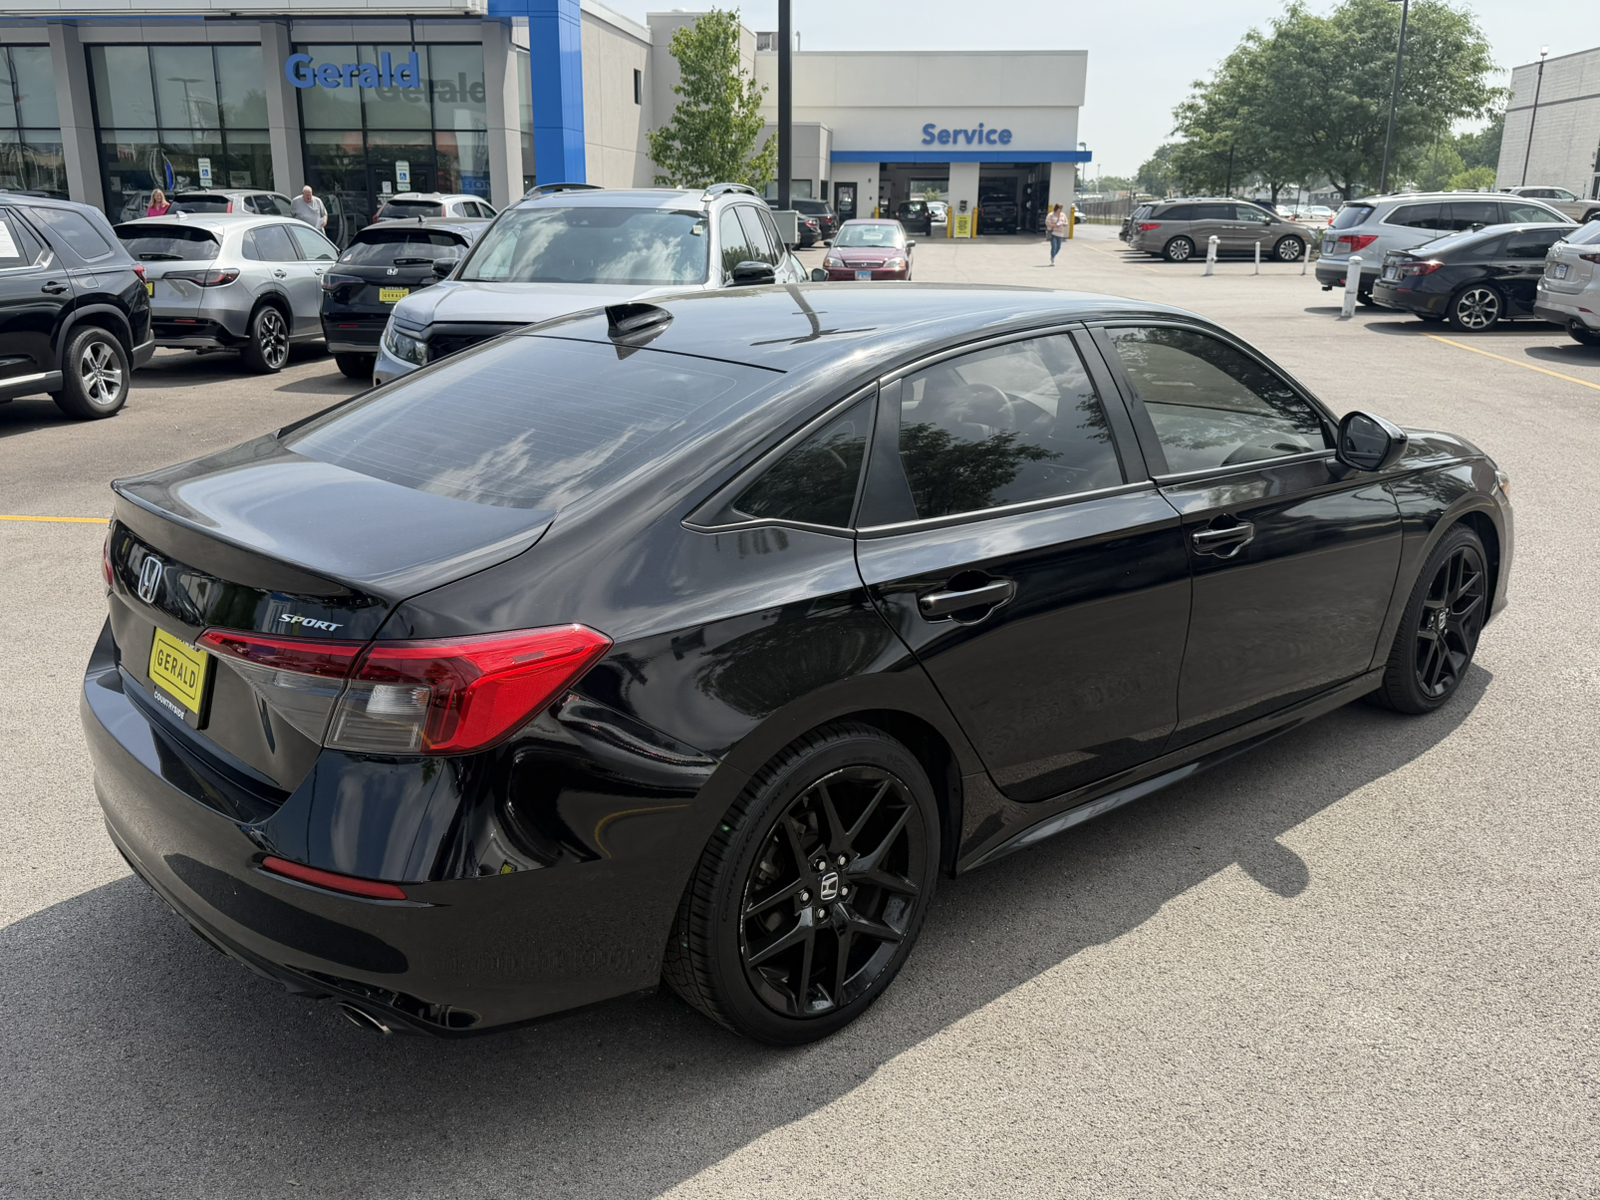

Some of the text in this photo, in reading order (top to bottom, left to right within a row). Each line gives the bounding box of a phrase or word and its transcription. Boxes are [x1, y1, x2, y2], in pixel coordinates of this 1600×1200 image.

[285, 51, 420, 89] Gerald
[921, 122, 1012, 145] Service
[279, 613, 344, 632] SPORT
[156, 649, 197, 689] GERALD
[153, 691, 185, 720] COUNTRYSIDE
